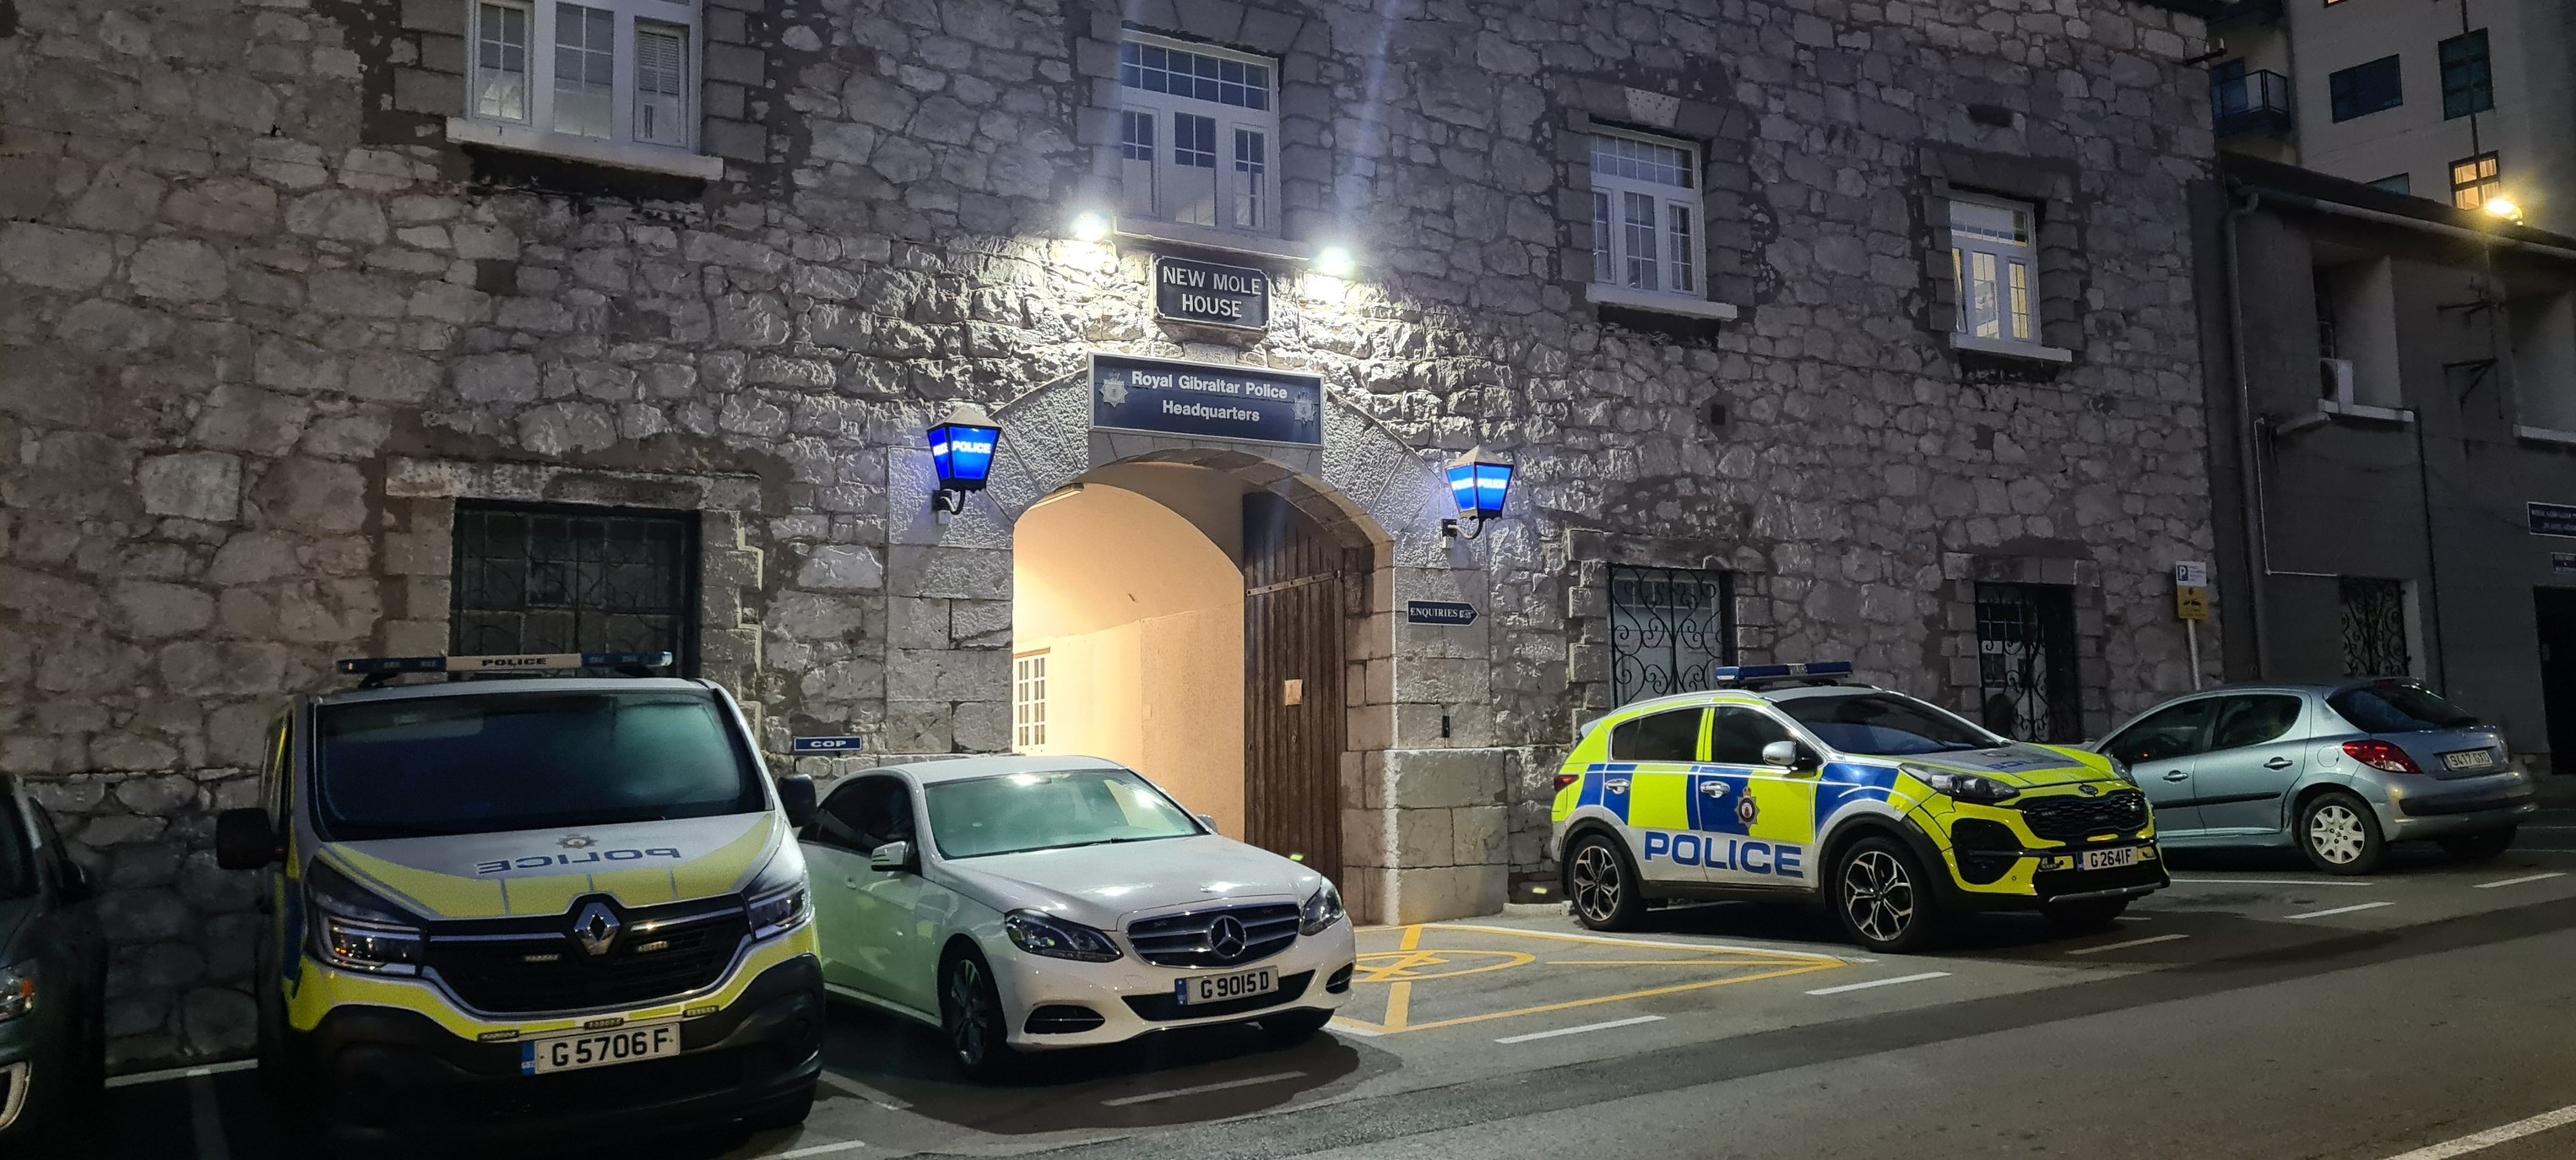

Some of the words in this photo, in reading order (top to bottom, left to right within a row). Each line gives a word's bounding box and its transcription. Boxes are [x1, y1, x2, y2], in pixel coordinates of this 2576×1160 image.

[1163, 266, 1206, 288] NEW
[1213, 273, 1262, 295] MOLE
[1182, 293, 1242, 318] HOUSE
[1131, 370, 1173, 389] Royal
[1178, 375, 1240, 395] Gibraltar
[1245, 382, 1288, 399] Police
[1162, 400, 1261, 422] Headquarters
[952, 441, 991, 454] POLICE
[1410, 607, 1458, 619] ENQUIRIES
[481, 658, 546, 666] POLICE
[1644, 831, 1804, 879] POLICE
[2091, 853, 2098, 868] G
[1201, 979, 1213, 999] G
[1217, 973, 1256, 997] 9015
[1259, 971, 1269, 990] D
[551, 1042, 569, 1067] G
[576, 1031, 648, 1064] 5706
[653, 1027, 670, 1053] F
